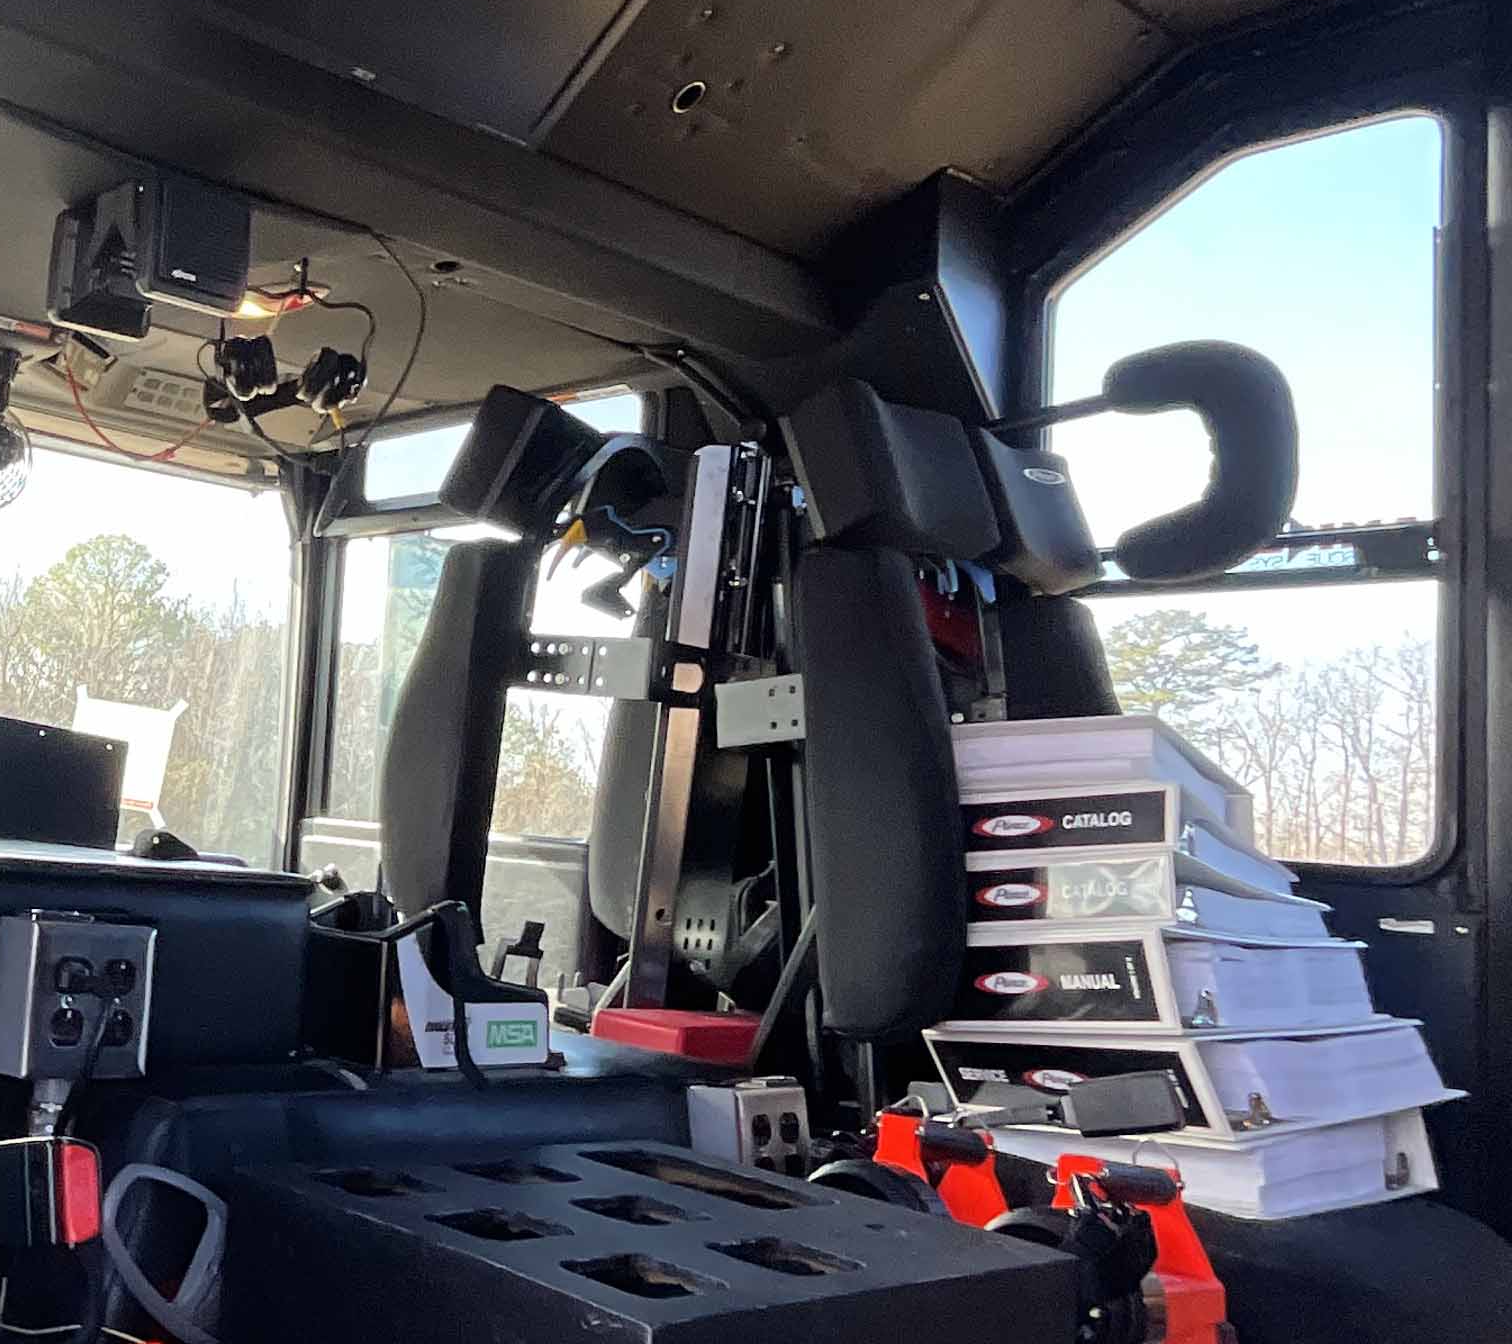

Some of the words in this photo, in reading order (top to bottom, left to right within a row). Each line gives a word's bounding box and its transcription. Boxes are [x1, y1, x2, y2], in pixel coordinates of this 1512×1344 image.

[1062, 811, 1133, 830] CATALOG
[1062, 879, 1129, 899] CATALOG
[1059, 973, 1121, 990] MANUAL
[489, 1023, 535, 1046] MSA
